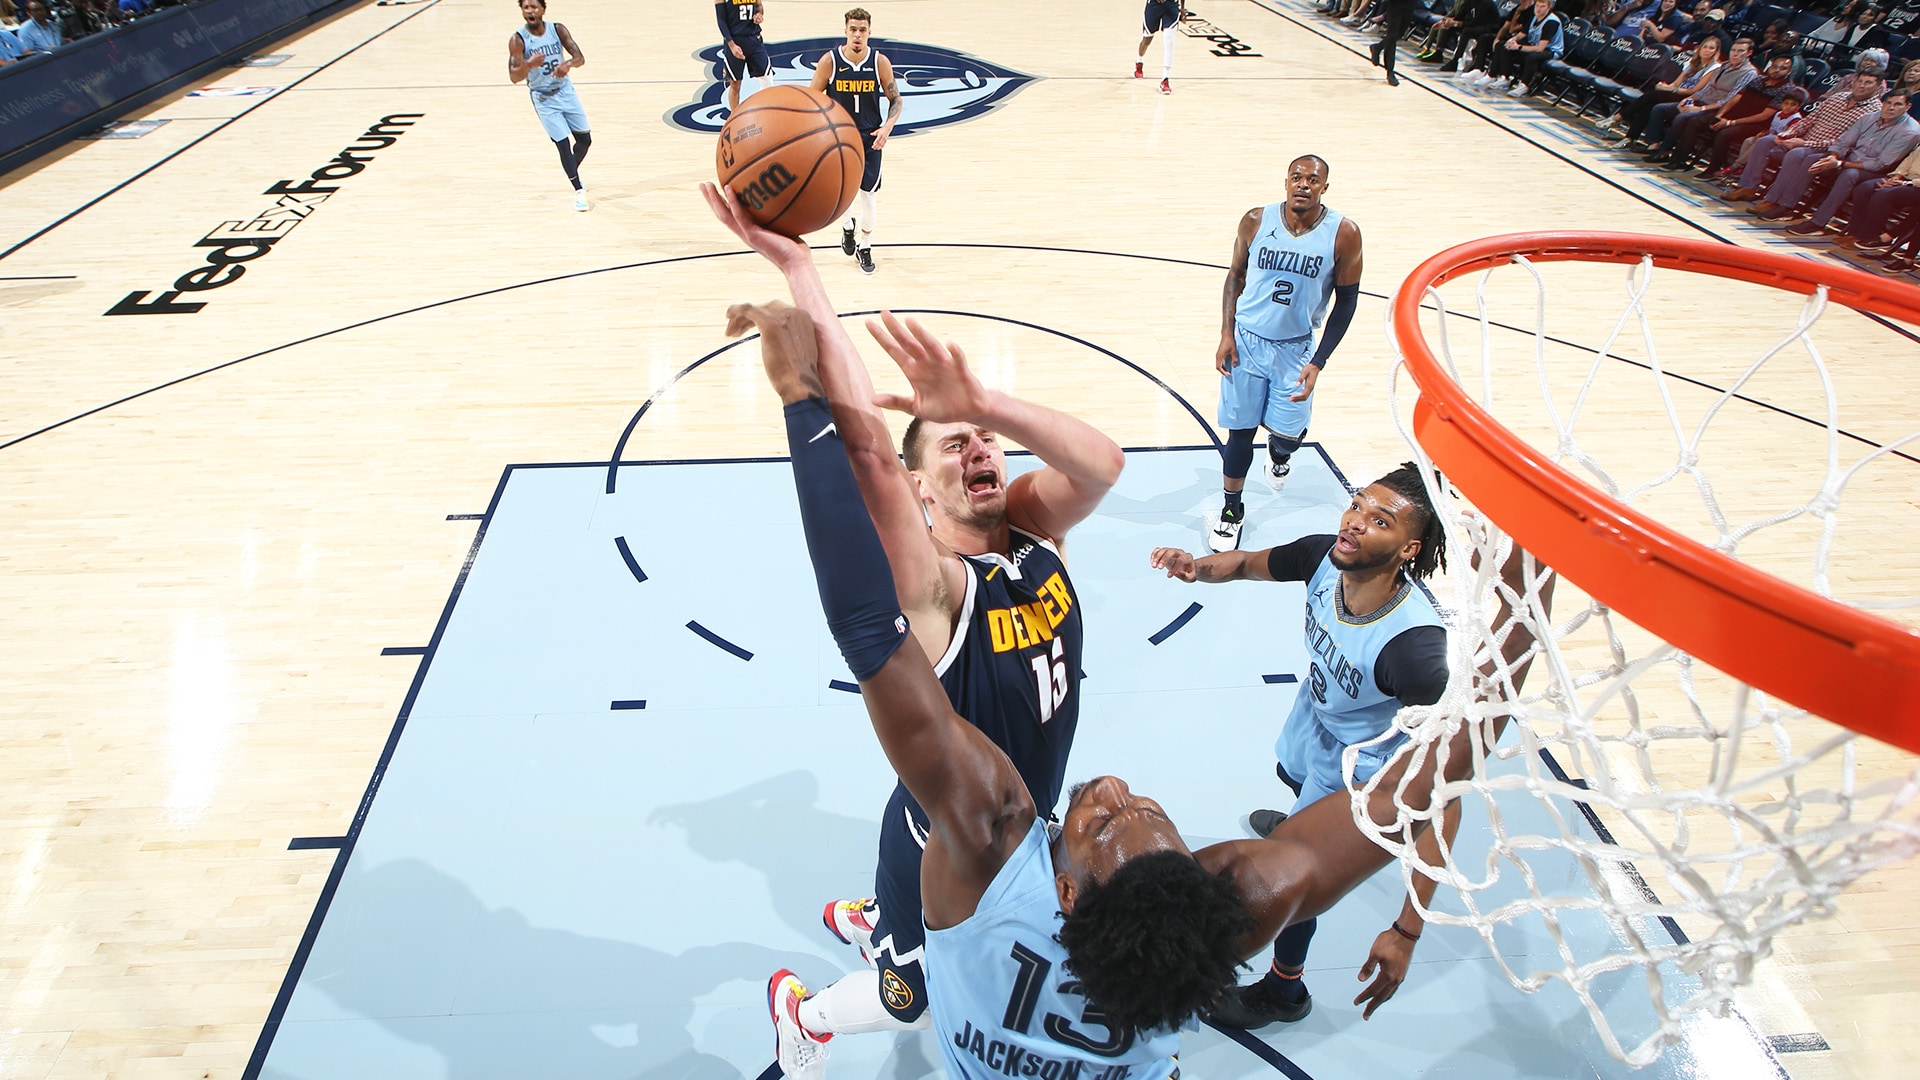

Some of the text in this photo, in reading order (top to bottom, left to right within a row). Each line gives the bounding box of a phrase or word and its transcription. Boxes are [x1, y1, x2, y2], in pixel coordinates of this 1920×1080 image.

[739, 4, 754, 20] 27
[8, 86, 66, 120] Wellness
[835, 79, 875, 93] DENVER
[853, 94, 860, 114] 1
[102, 113, 426, 316] FedExForum
[1257, 246, 1324, 279] GRIZZLIES
[1271, 280, 1294, 306] 2
[986, 571, 1073, 654] DENER
[1031, 634, 1068, 724] 15
[1002, 940, 1136, 1058] 13
[954, 1019, 1083, 1080] JACKSON
